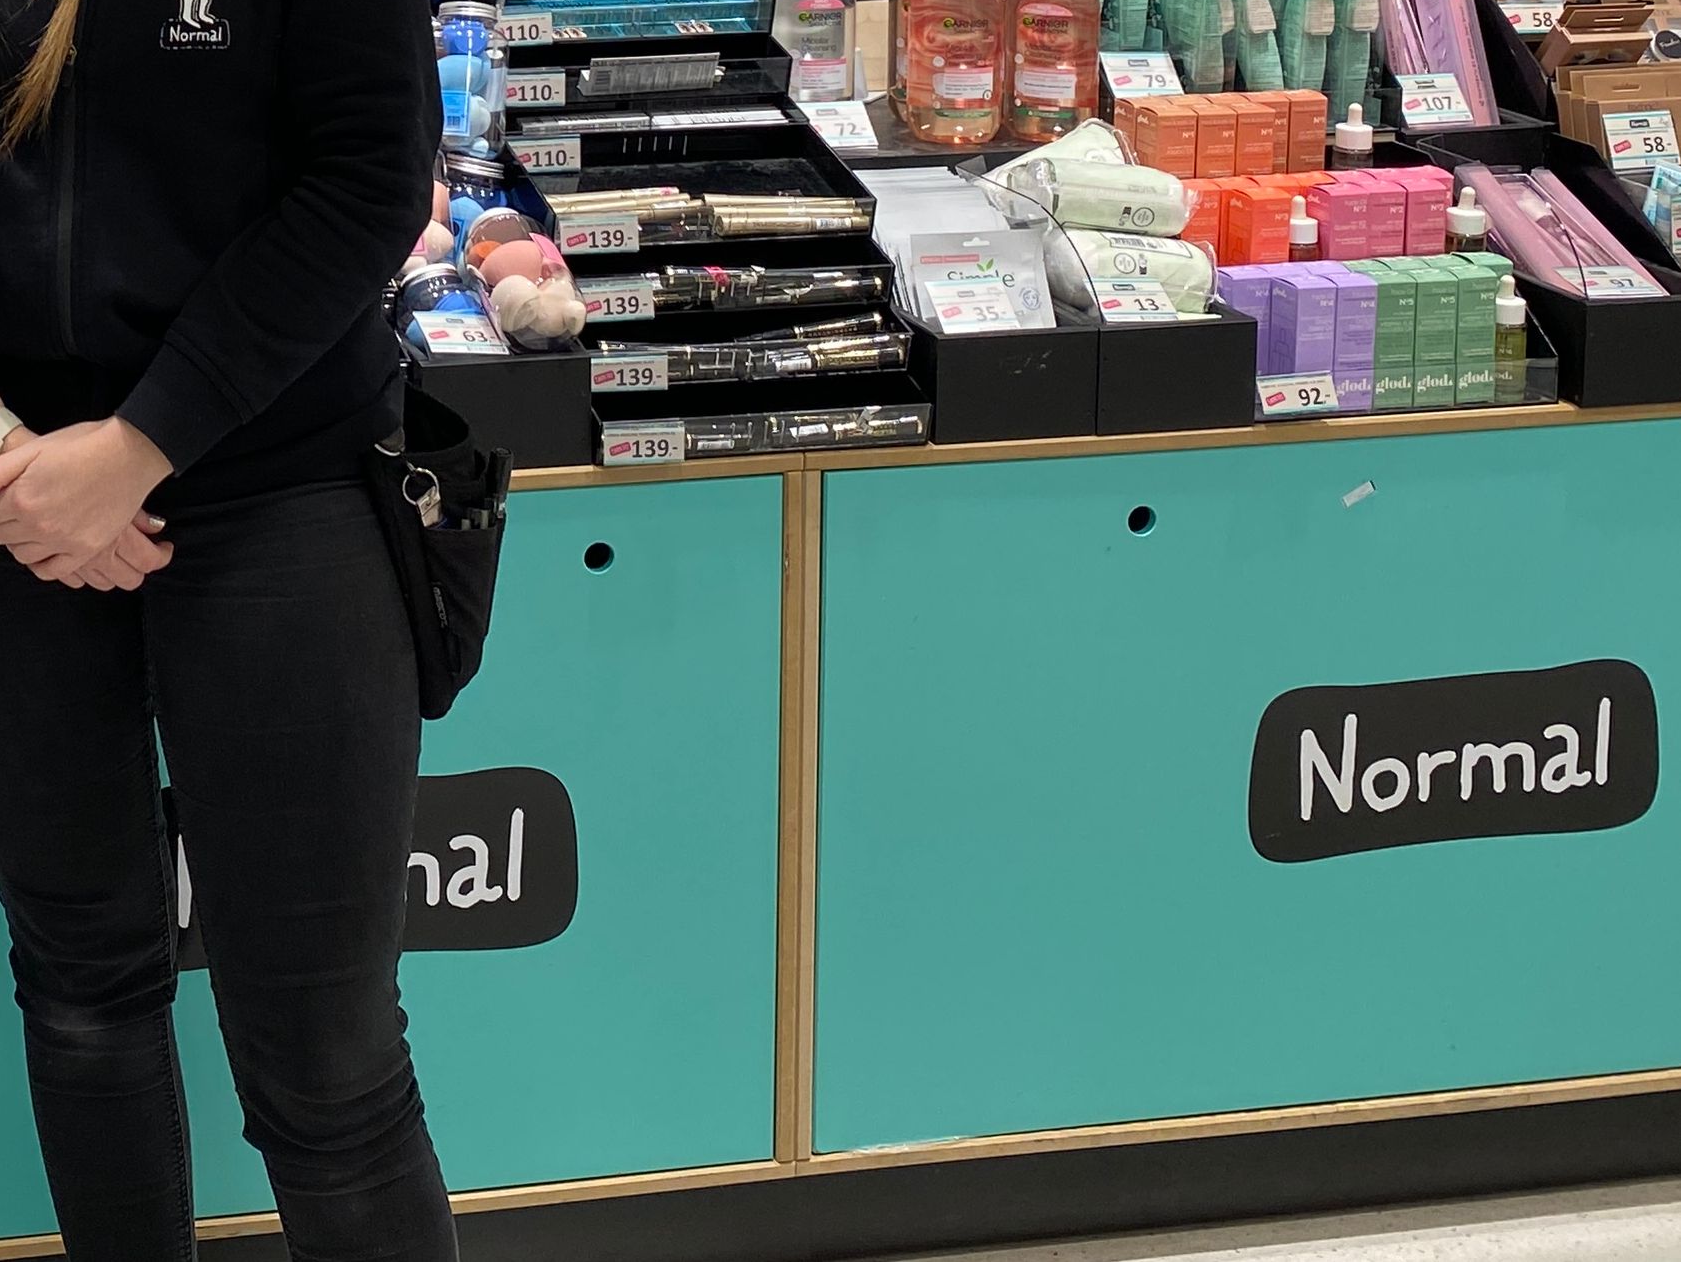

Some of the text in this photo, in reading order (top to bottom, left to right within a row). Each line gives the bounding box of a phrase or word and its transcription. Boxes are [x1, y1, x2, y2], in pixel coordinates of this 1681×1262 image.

[798, 11, 842, 24] GARNIER
[943, 17, 989, 30] GARNIER
[1022, 17, 1069, 29] GARNIER
[169, 26, 222, 42] Normal
[1299, 697, 1610, 821] Normal
